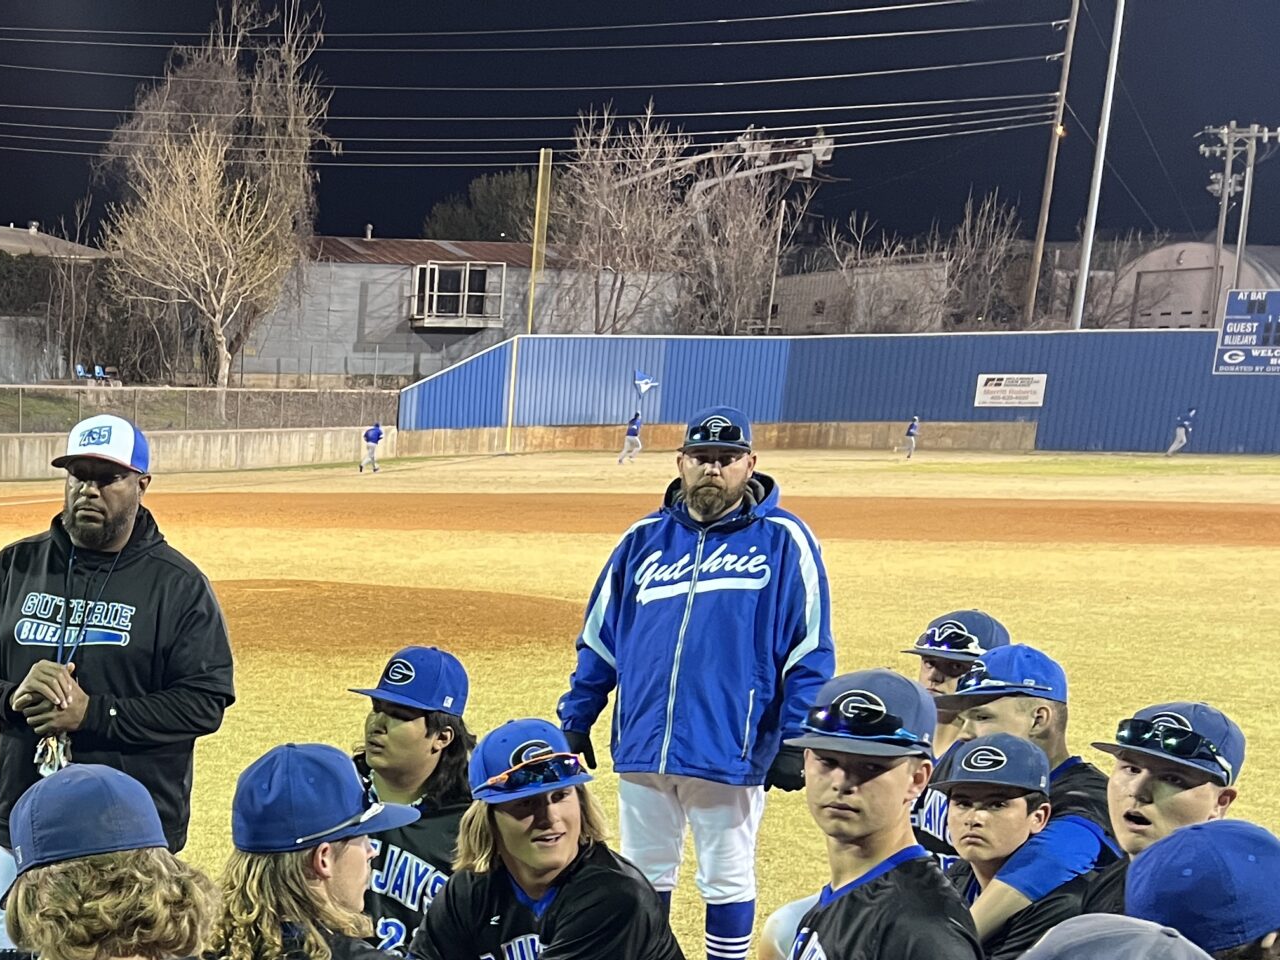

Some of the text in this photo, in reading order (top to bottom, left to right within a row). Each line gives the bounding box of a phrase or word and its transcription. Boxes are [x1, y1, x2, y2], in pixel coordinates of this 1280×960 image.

[1237, 292, 1267, 300] AT BAT
[1224, 335, 1257, 345] BLUEJAYS
[1226, 322, 1259, 333] GUEST
[634, 543, 770, 588] Guthrie
[21, 592, 136, 631] GUTHRIE
[383, 658, 416, 685] G
[961, 745, 1008, 772] G
